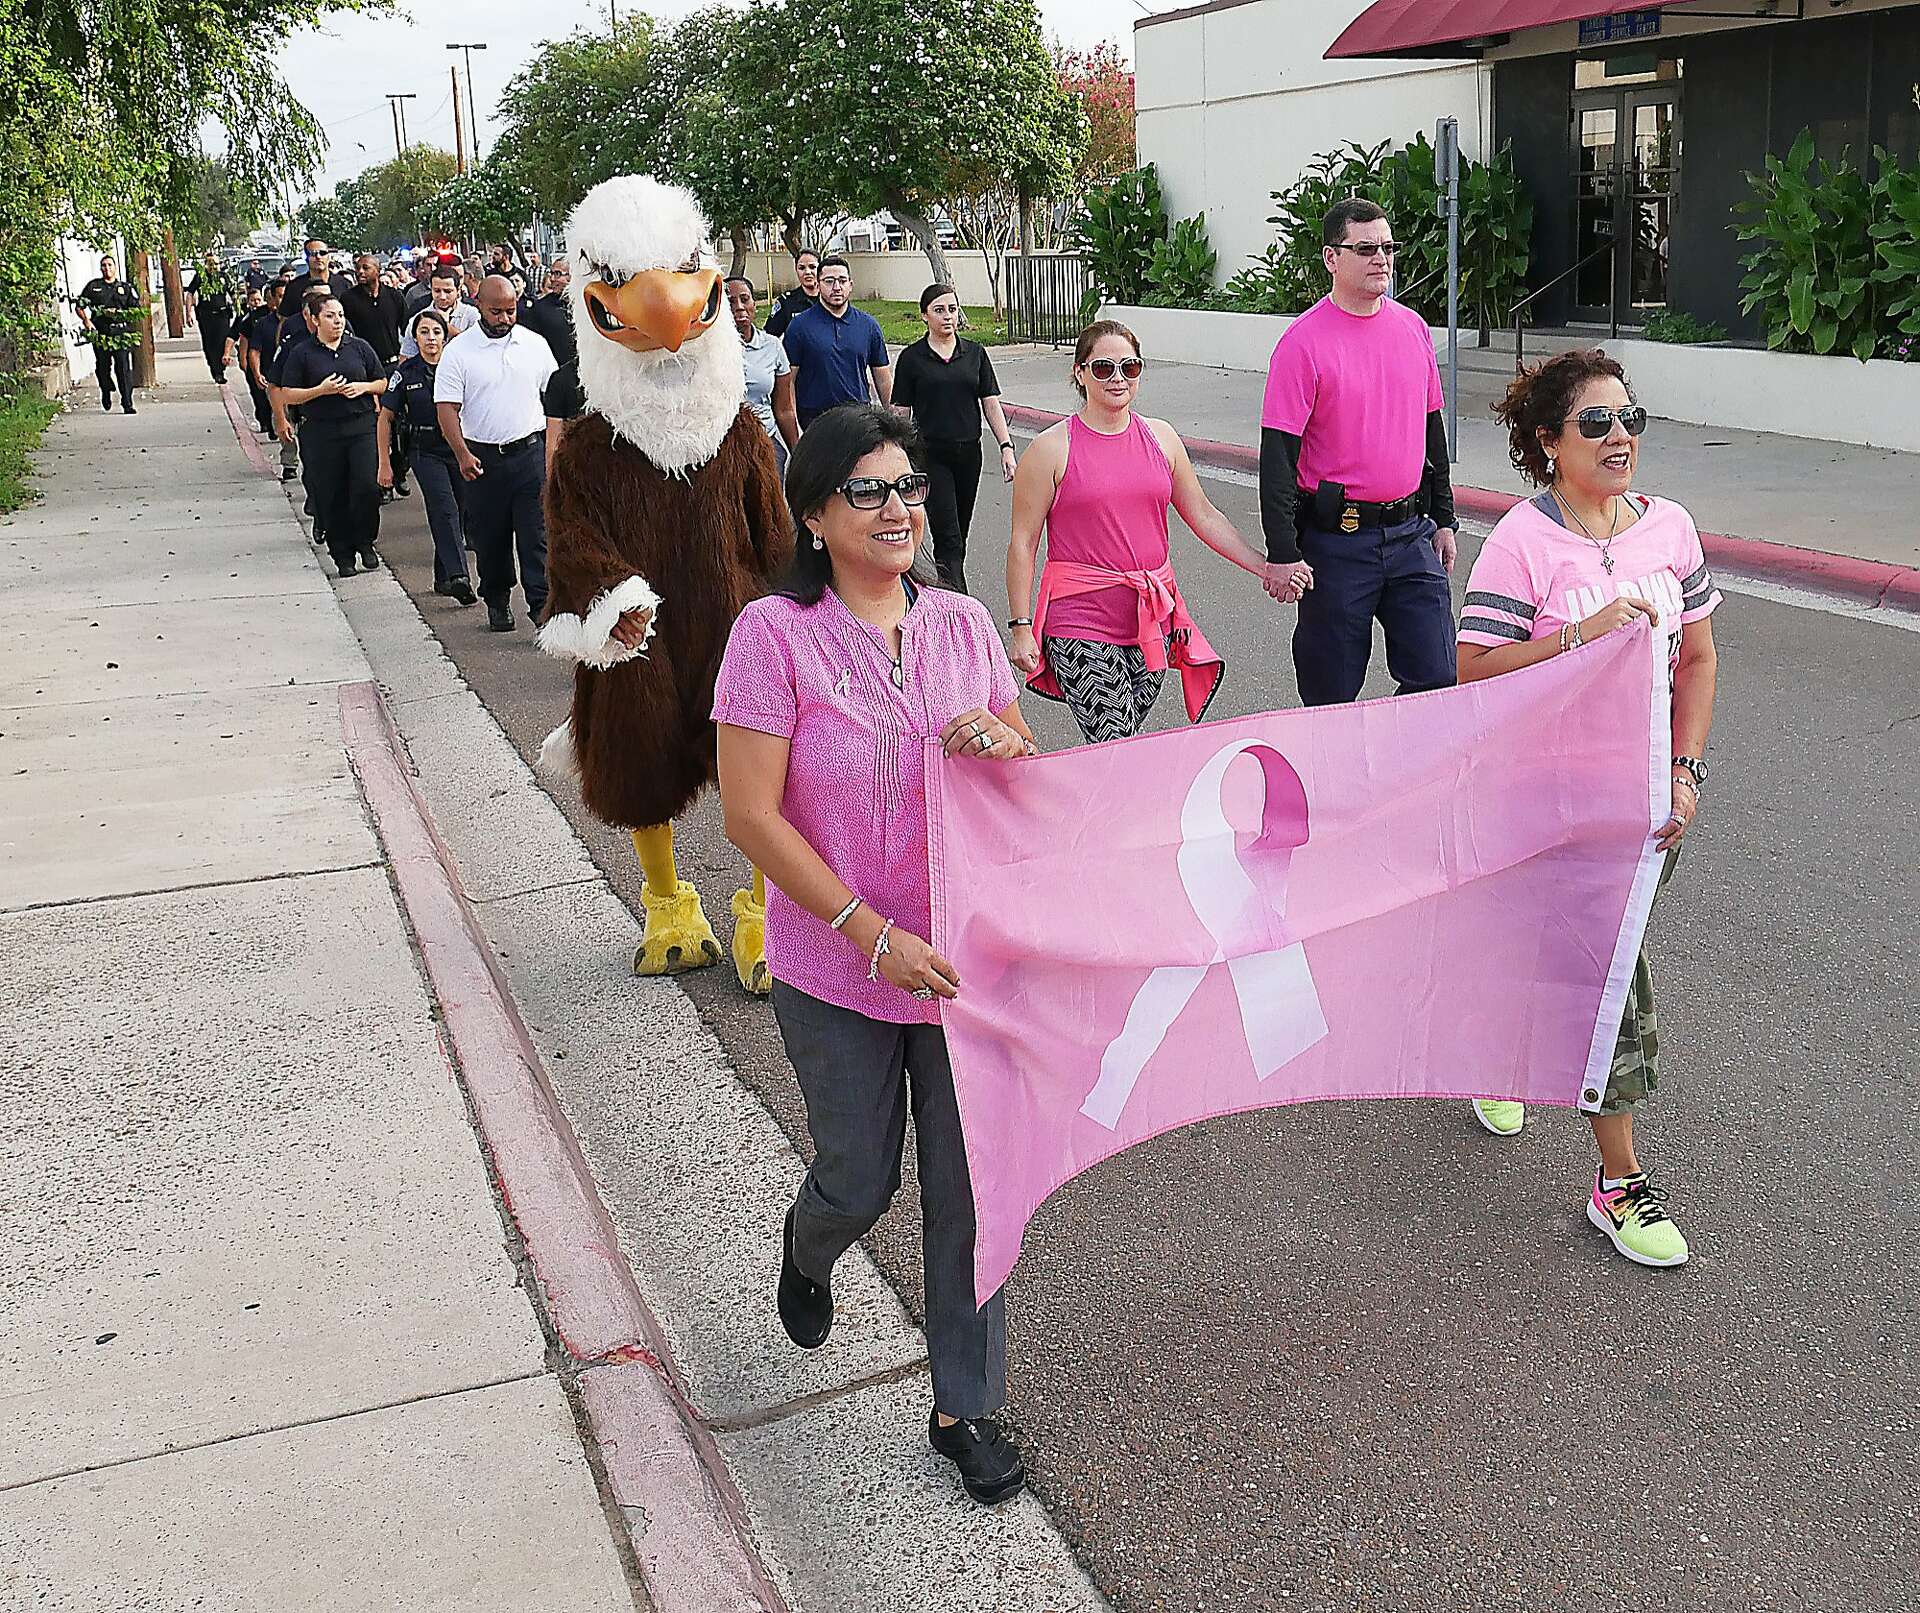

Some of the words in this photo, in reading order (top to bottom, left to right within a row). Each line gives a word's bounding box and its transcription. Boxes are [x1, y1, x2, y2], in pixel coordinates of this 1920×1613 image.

[1610, 25, 1631, 40] SERVICE
[1636, 21, 1656, 35] CENTER
[1564, 584, 1606, 623] IN
